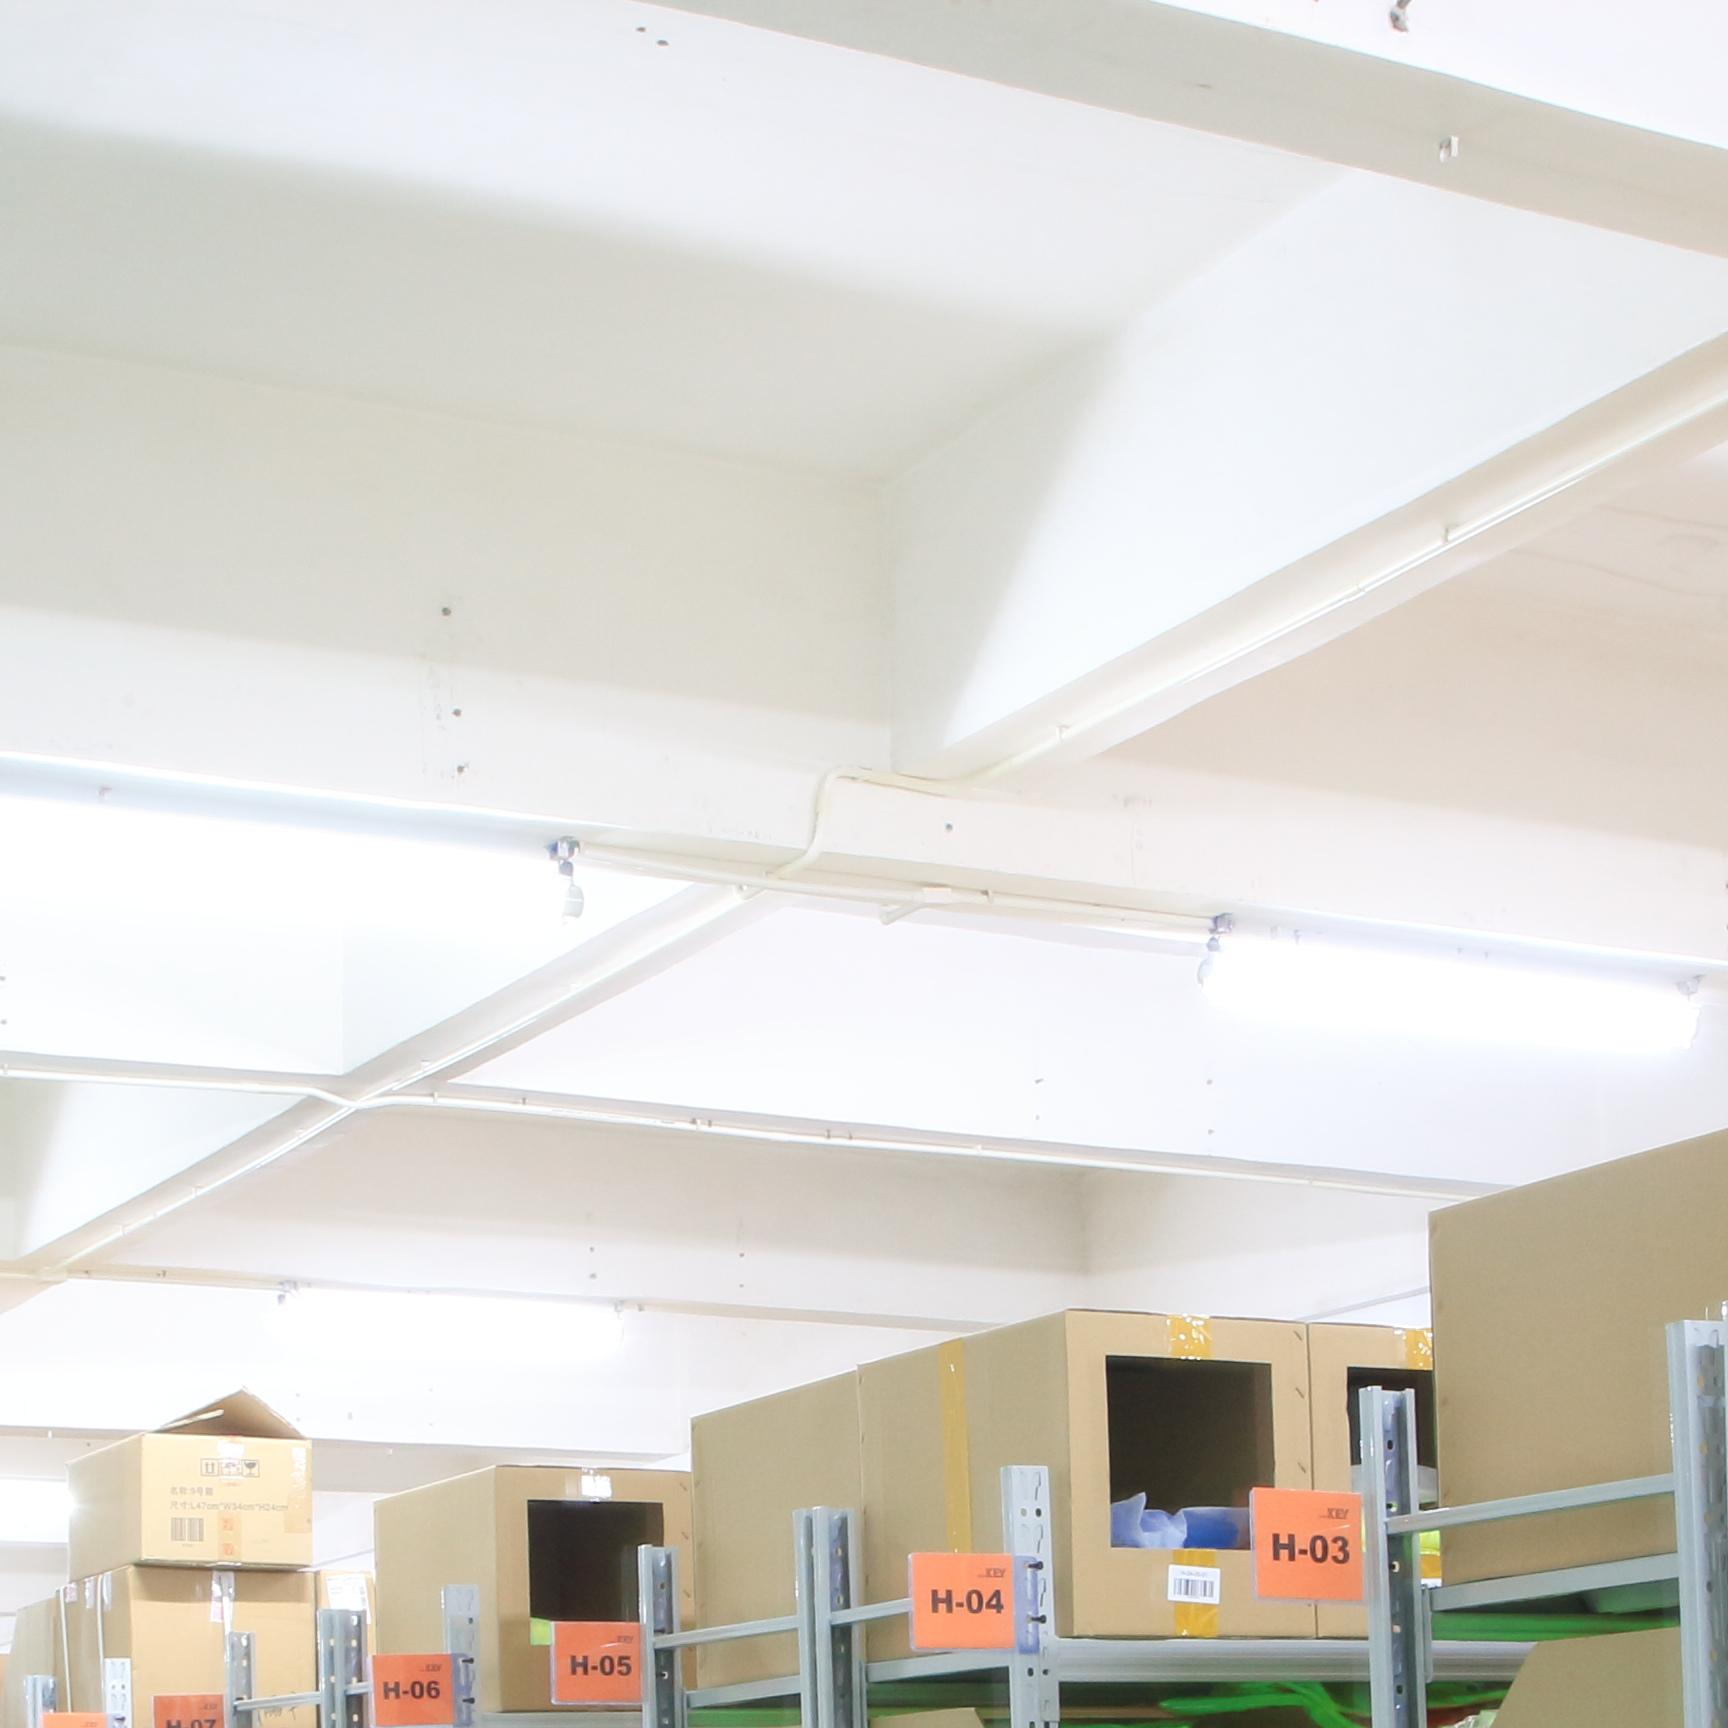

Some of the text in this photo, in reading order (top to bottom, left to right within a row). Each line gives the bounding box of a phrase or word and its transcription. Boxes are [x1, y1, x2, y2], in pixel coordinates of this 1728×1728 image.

[1272, 1533, 1350, 1564] H-03
[931, 1589, 1004, 1614] H-04
[570, 1655, 632, 1676] H-05
[383, 1680, 440, 1700] H-06
